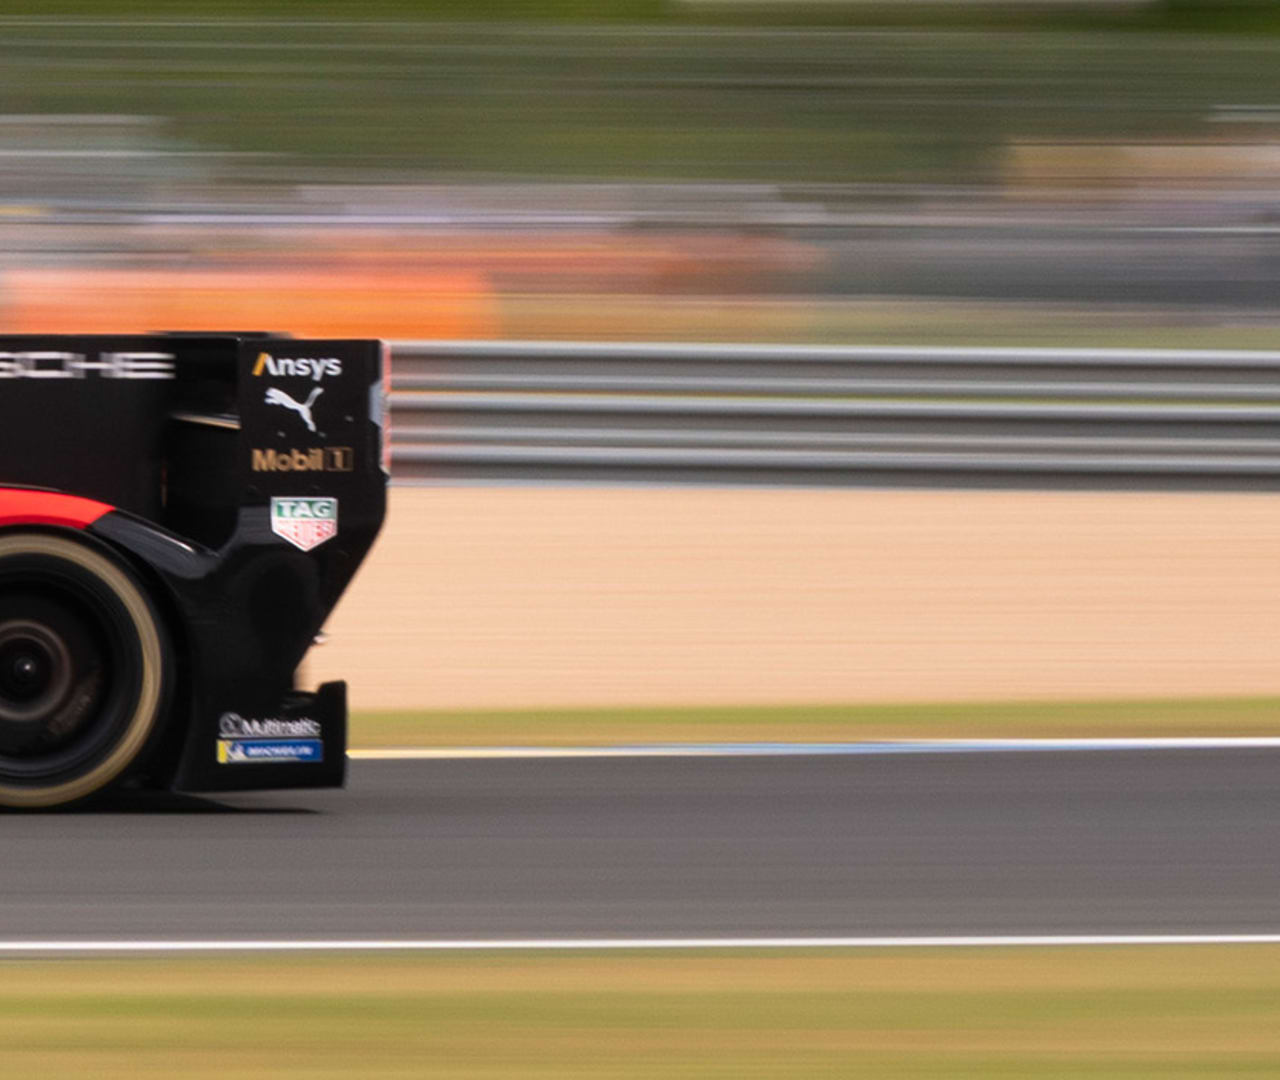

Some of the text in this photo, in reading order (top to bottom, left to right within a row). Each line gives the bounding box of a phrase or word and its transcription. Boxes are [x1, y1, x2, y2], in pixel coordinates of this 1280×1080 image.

[252, 352, 342, 382] Ansys
[252, 448, 323, 471] Mobil
[279, 502, 332, 518] TAG
